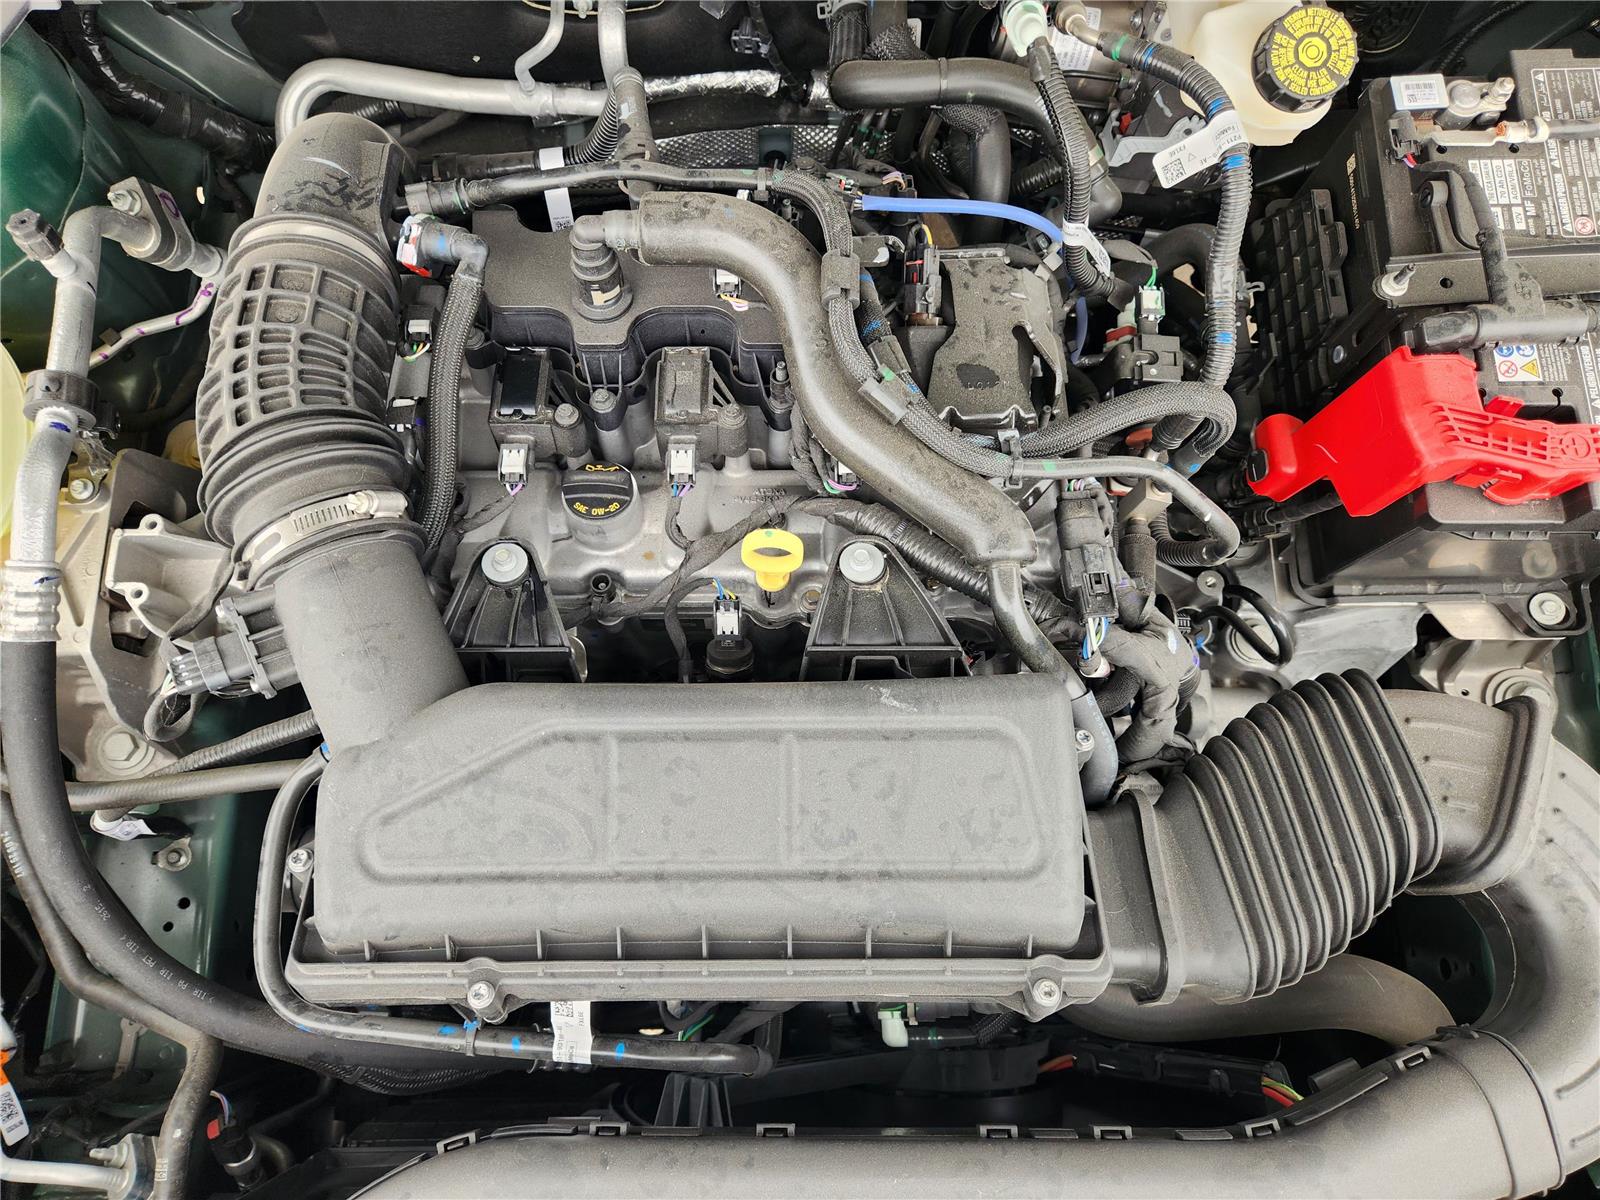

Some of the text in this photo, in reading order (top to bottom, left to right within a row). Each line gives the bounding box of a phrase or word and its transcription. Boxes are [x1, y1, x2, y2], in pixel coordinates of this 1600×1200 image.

[1329, 14, 1338, 23] LE
[1292, 64, 1328, 79] CLEAN FILLER
[1307, 80, 1318, 88] USE
[1318, 75, 1333, 87] ONLY
[1288, 82, 1308, 95] SEALED
[1497, 179, 1504, 190] Ah
[1506, 162, 1519, 200] AGM/VRLA
[1520, 160, 1533, 196] FoMoCo
[1499, 191, 1506, 201] 70
[1554, 174, 1568, 223] DANGER/POISON
[1524, 200, 1536, 216] MF
[573, 501, 588, 513] SAE
